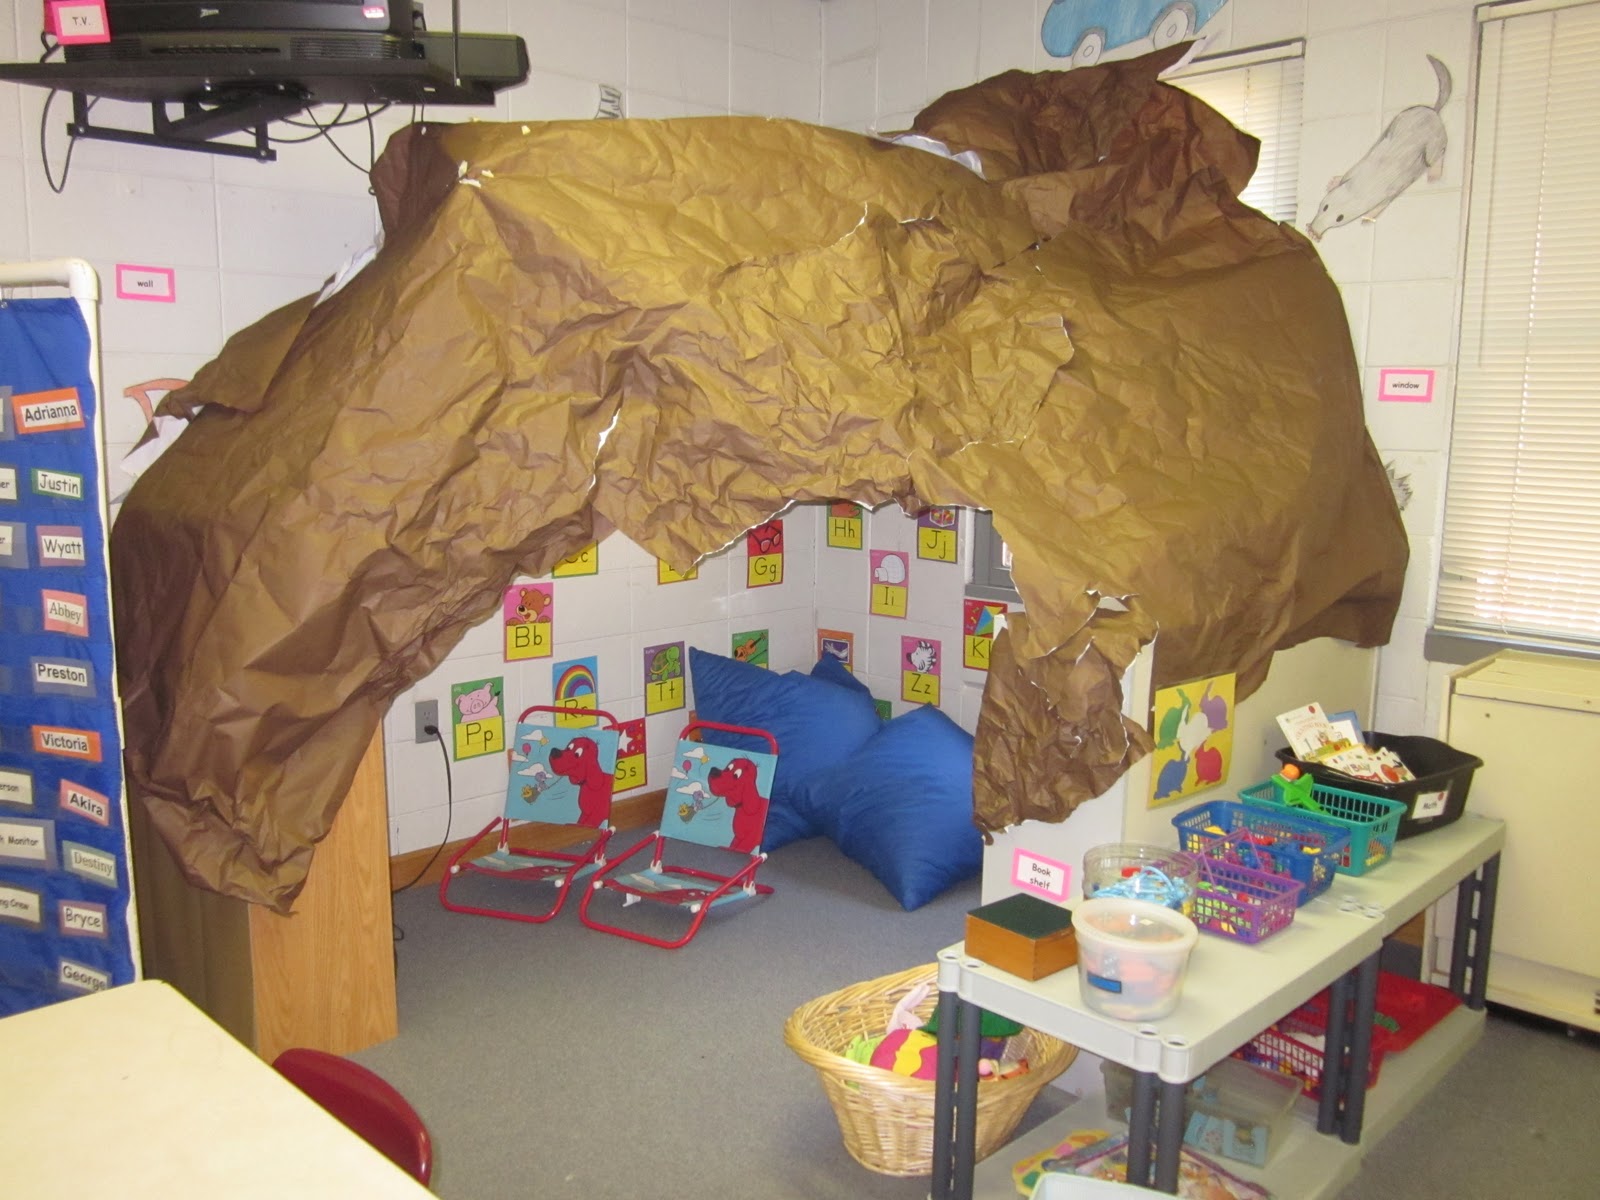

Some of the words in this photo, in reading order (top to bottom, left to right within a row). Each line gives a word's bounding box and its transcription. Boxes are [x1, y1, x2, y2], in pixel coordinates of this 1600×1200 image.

[137, 280, 153, 288] wall
[1392, 381, 1420, 389] window
[24, 404, 78, 424] Adrianna
[39, 473, 79, 496] Justin
[834, 520, 855, 539] Hh
[43, 538, 82, 558] Wyatt
[926, 529, 947, 560] Jj
[754, 557, 777, 583] Gg
[49, 602, 82, 624] Abbey
[514, 626, 543, 650] Bb
[37, 664, 86, 684] Preston
[910, 673, 932, 695] Zz
[655, 681, 675, 702] Tt
[41, 732, 89, 753] Victoria
[465, 722, 494, 752] Pp
[615, 760, 637, 780] Ss
[70, 793, 104, 818] Akira
[8, 835, 40, 848] Monitor
[74, 851, 114, 877] Destiny
[1032, 862, 1051, 877] Book
[1030, 877, 1051, 890] shelf
[65, 907, 101, 929] Bryce
